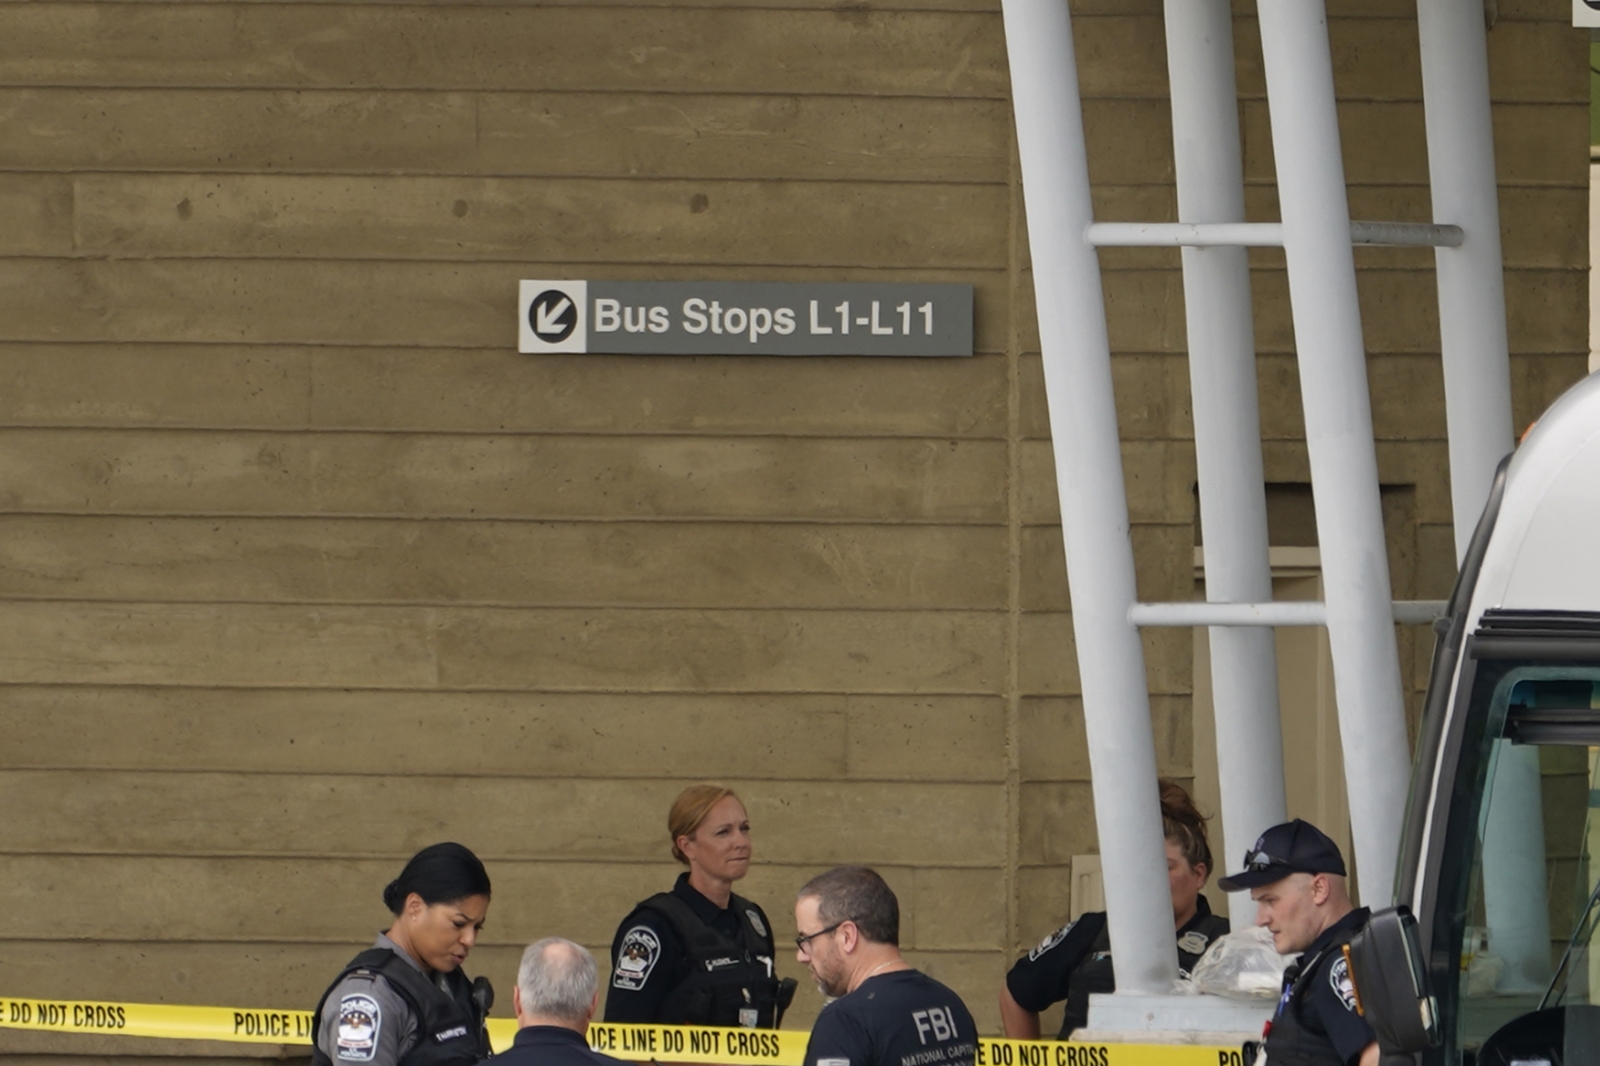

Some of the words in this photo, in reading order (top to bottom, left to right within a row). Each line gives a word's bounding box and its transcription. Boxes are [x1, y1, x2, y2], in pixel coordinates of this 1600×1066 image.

[594, 298, 670, 334] Bus
[682, 298, 796, 343] Stops
[809, 300, 934, 336] L1-L11
[10, 1002, 32, 1024] DO
[37, 1003, 68, 1027] NOT
[73, 1004, 126, 1029] CROSS
[233, 1012, 290, 1037] POLICE
[296, 1014, 315, 1038] LI
[911, 1005, 959, 1046] FBI
[590, 1026, 617, 1051] ICE
[622, 1028, 657, 1053] LINE
[662, 1029, 684, 1054] DO
[690, 1030, 721, 1055] NOT
[726, 1031, 780, 1057] CROSS
